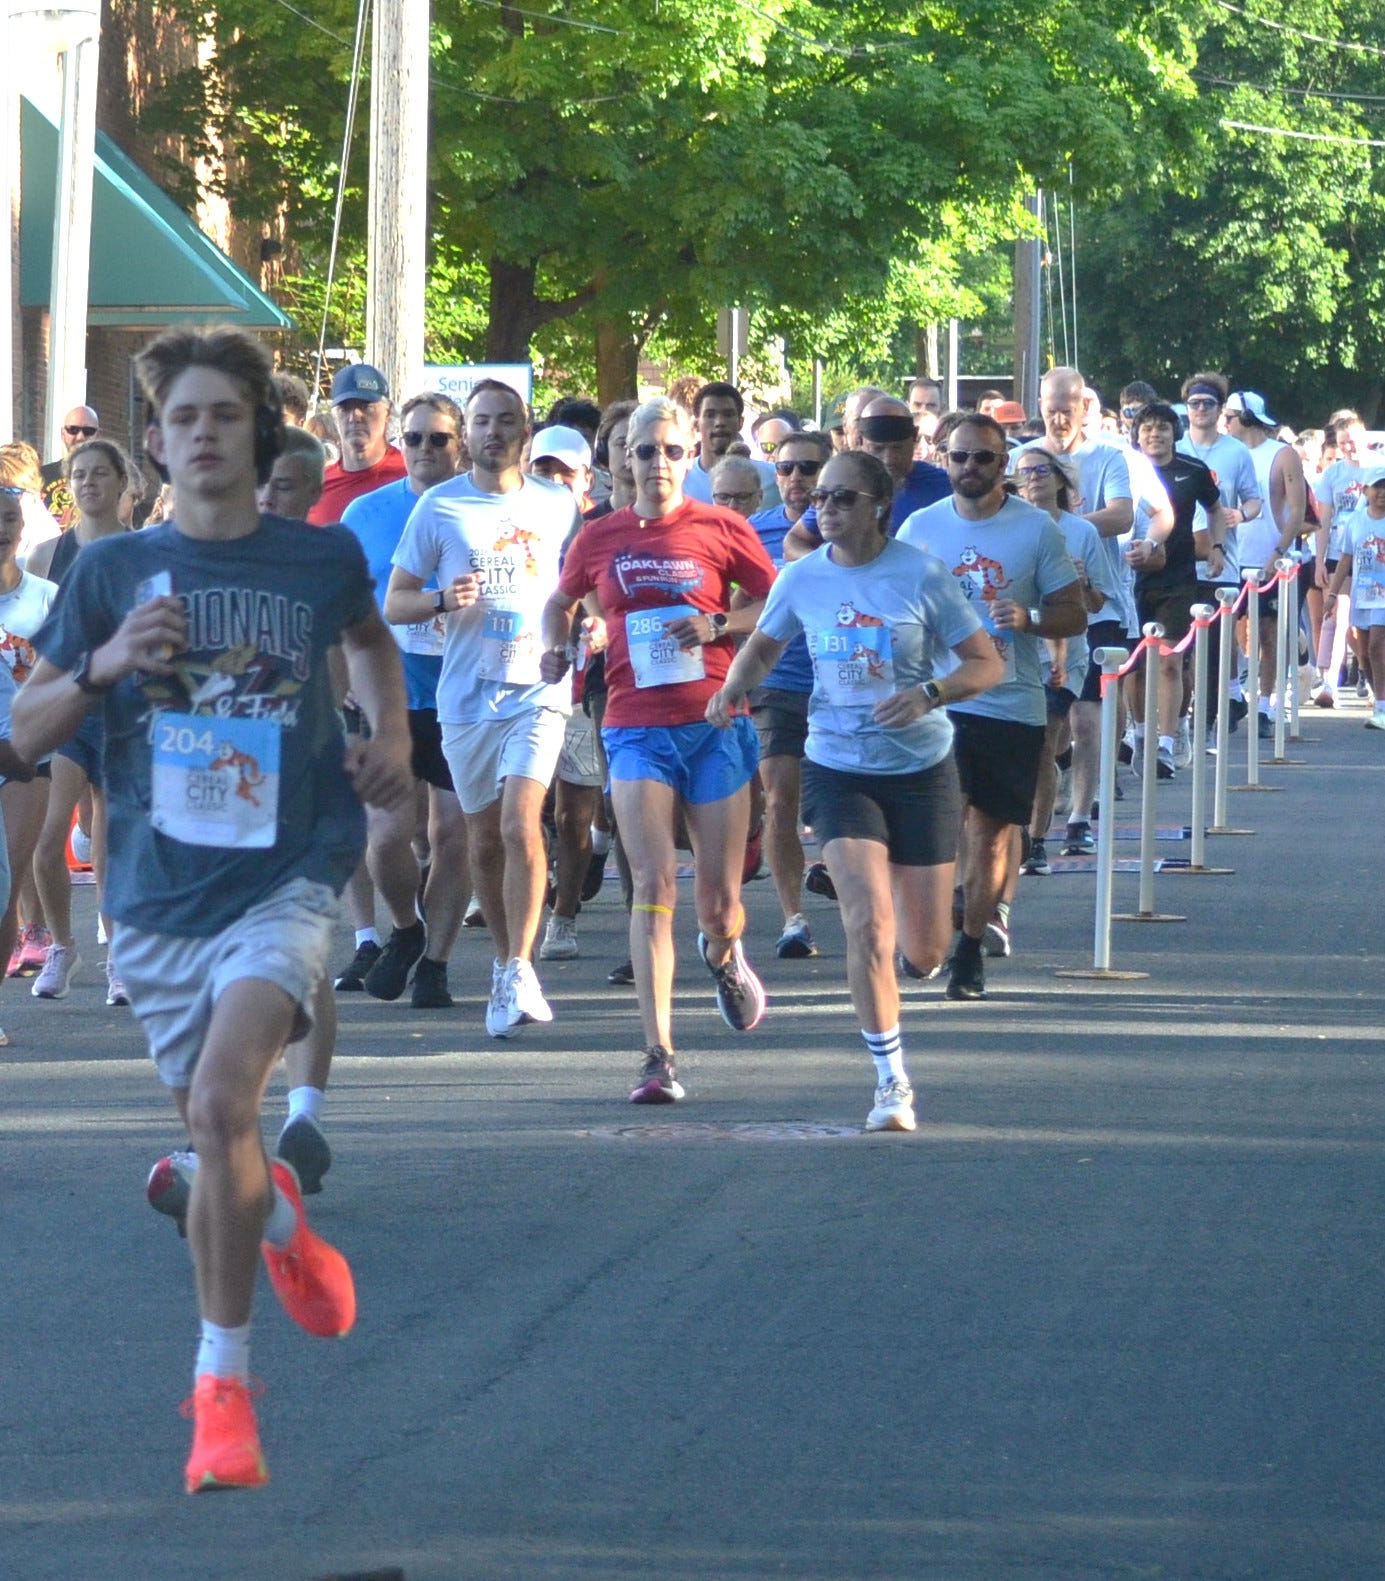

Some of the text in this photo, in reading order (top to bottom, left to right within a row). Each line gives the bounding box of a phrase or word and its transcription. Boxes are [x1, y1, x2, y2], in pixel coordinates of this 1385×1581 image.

[469, 557, 515, 568] CEREAL
[621, 560, 695, 571] OAKLAWN
[472, 568, 516, 585] CITY
[479, 584, 517, 596] LASSIC
[492, 617, 514, 633] 111
[631, 617, 663, 635] 286
[823, 635, 848, 652] 131
[650, 649, 675, 660] CITY
[838, 670, 864, 680] CITY
[160, 726, 214, 755] 204
[186, 785, 228, 801] CITY
